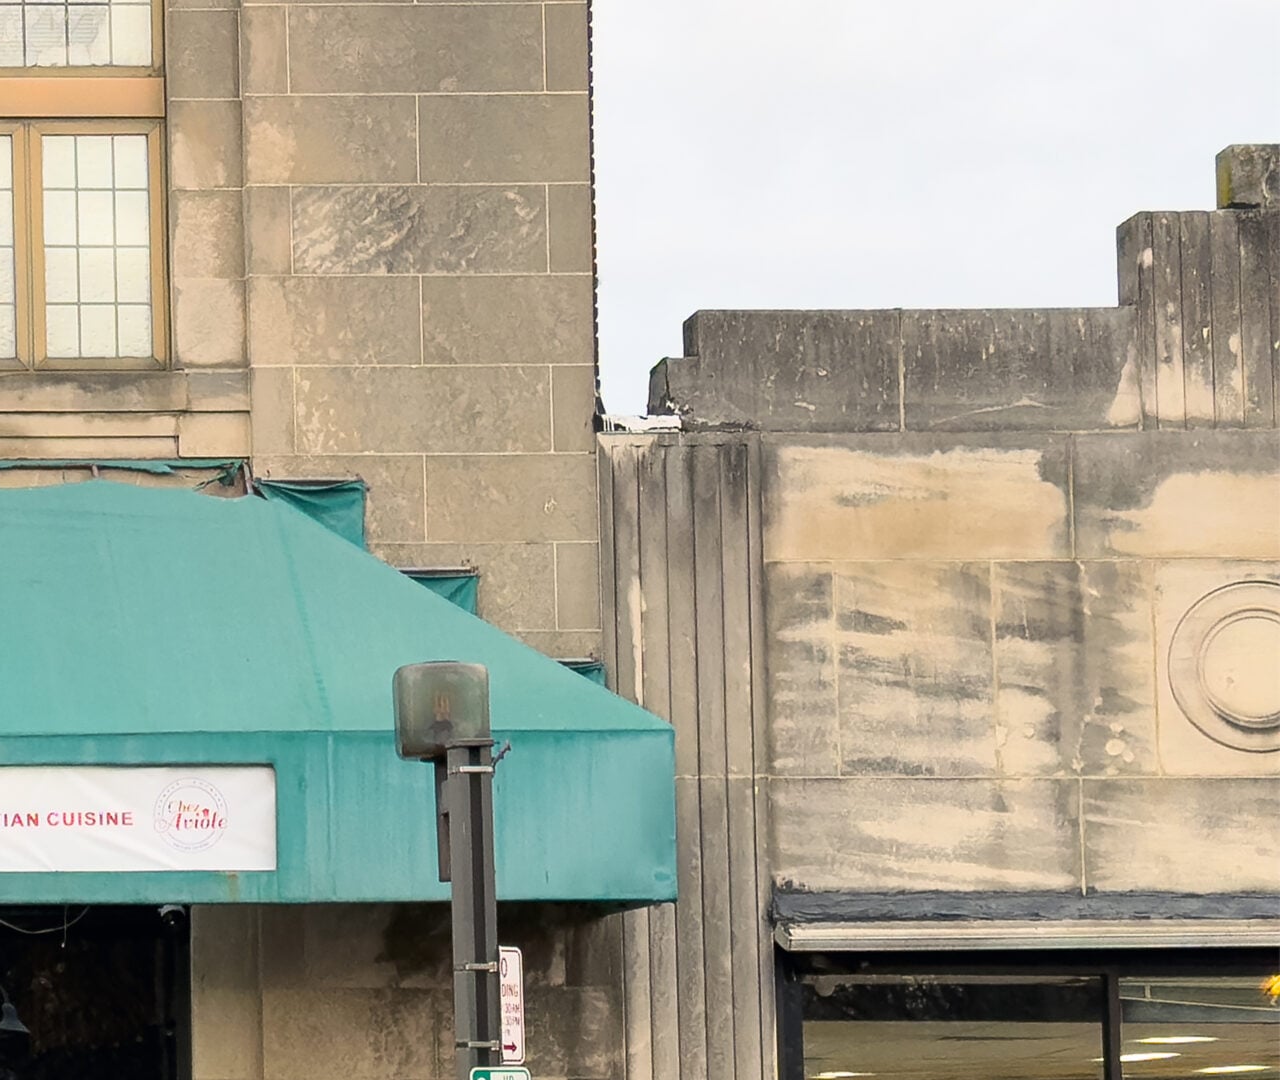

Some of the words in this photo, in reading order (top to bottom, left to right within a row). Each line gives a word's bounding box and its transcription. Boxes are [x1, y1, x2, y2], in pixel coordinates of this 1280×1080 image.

[47, 811, 134, 828] CUISINE
[501, 957, 508, 978] O
[502, 984, 519, 997] DING
